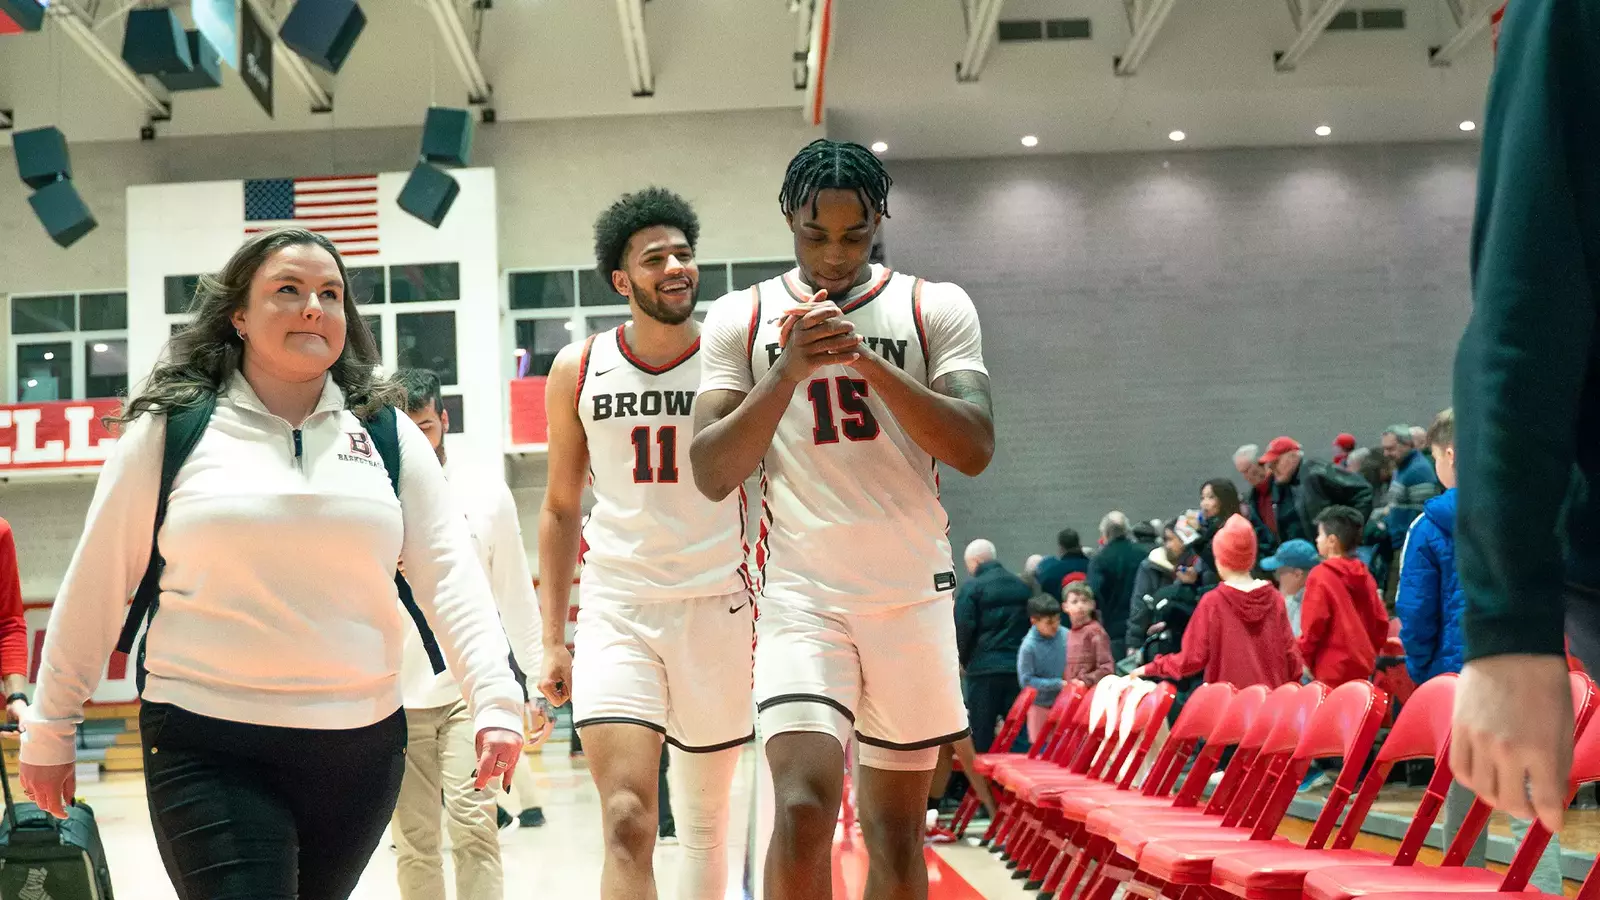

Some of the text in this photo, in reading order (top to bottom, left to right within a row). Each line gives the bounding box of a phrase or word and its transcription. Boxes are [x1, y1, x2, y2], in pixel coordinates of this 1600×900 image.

[592, 390, 696, 421] BROW
[807, 375, 881, 445] 15
[0, 406, 118, 464] LL
[348, 431, 373, 458] B
[630, 425, 679, 484] 11
[337, 453, 382, 469] BASKETBA
